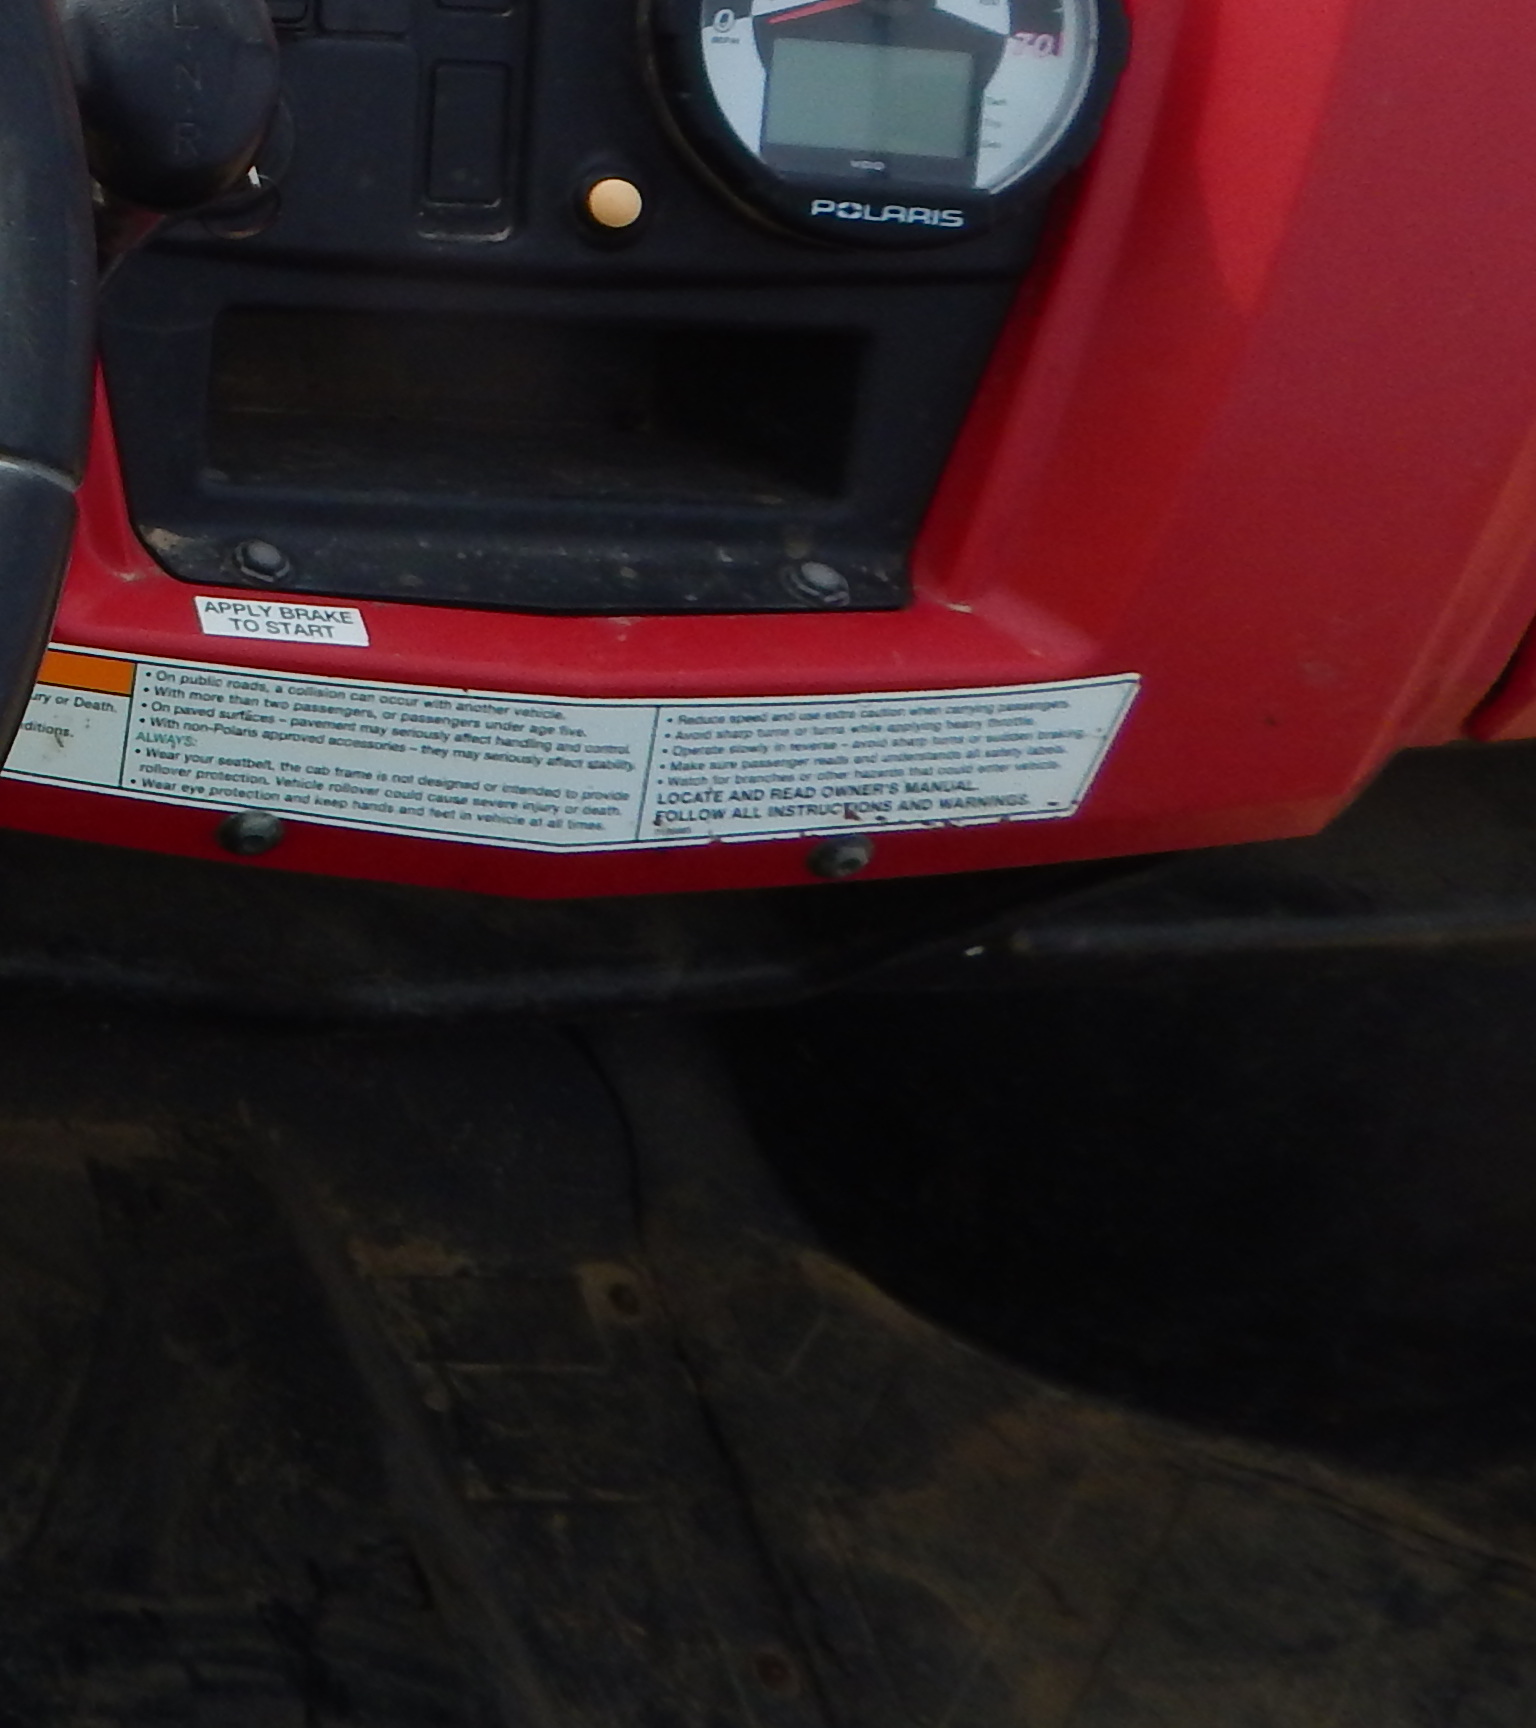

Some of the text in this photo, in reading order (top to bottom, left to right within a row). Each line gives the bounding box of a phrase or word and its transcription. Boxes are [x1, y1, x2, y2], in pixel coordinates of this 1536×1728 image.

[713, 8, 735, 33] 0
[1010, 32, 1055, 58] 70
[811, 199, 965, 227] POLARIS
[204, 600, 354, 625] APPLY BRAKE
[229, 617, 335, 639] TO START
[55, 696, 70, 705] or
[73, 696, 117, 713] Death.
[156, 670, 565, 720] On public roads, a collision can occur with another vehicle.
[154, 685, 587, 737] With more than two passengers, or passengers under age five.
[135, 731, 197, 748] ALWAYS:
[151, 700, 170, 713] On
[174, 705, 215, 717] paved
[290, 716, 356, 731] pavement
[360, 724, 388, 737] may
[392, 727, 450, 743] seriously
[454, 732, 491, 745] affect
[495, 736, 552, 753] handling
[556, 743, 581, 752] and
[584, 744, 630, 754] control.
[150, 716, 635, 772] With non-Polaris approved accessories they may seriously affect stability.
[145, 747, 630, 801] Wear your seatbelt, the cab frame is not designed or intended to provide
[139, 763, 620, 816] rollover protection. Vehicle rollover could cause severe injury or death.
[657, 790, 724, 805] LOCATE
[729, 789, 765, 802] AND
[770, 786, 816, 800] READ
[821, 782, 899, 798] OWNER'S
[142, 777, 605, 830] Wear eye protection and keep hands and feet in vehicle at all times.
[654, 808, 725, 822] FOLLOW
[732, 807, 762, 819] ALL
[898, 798, 933, 811] AND
